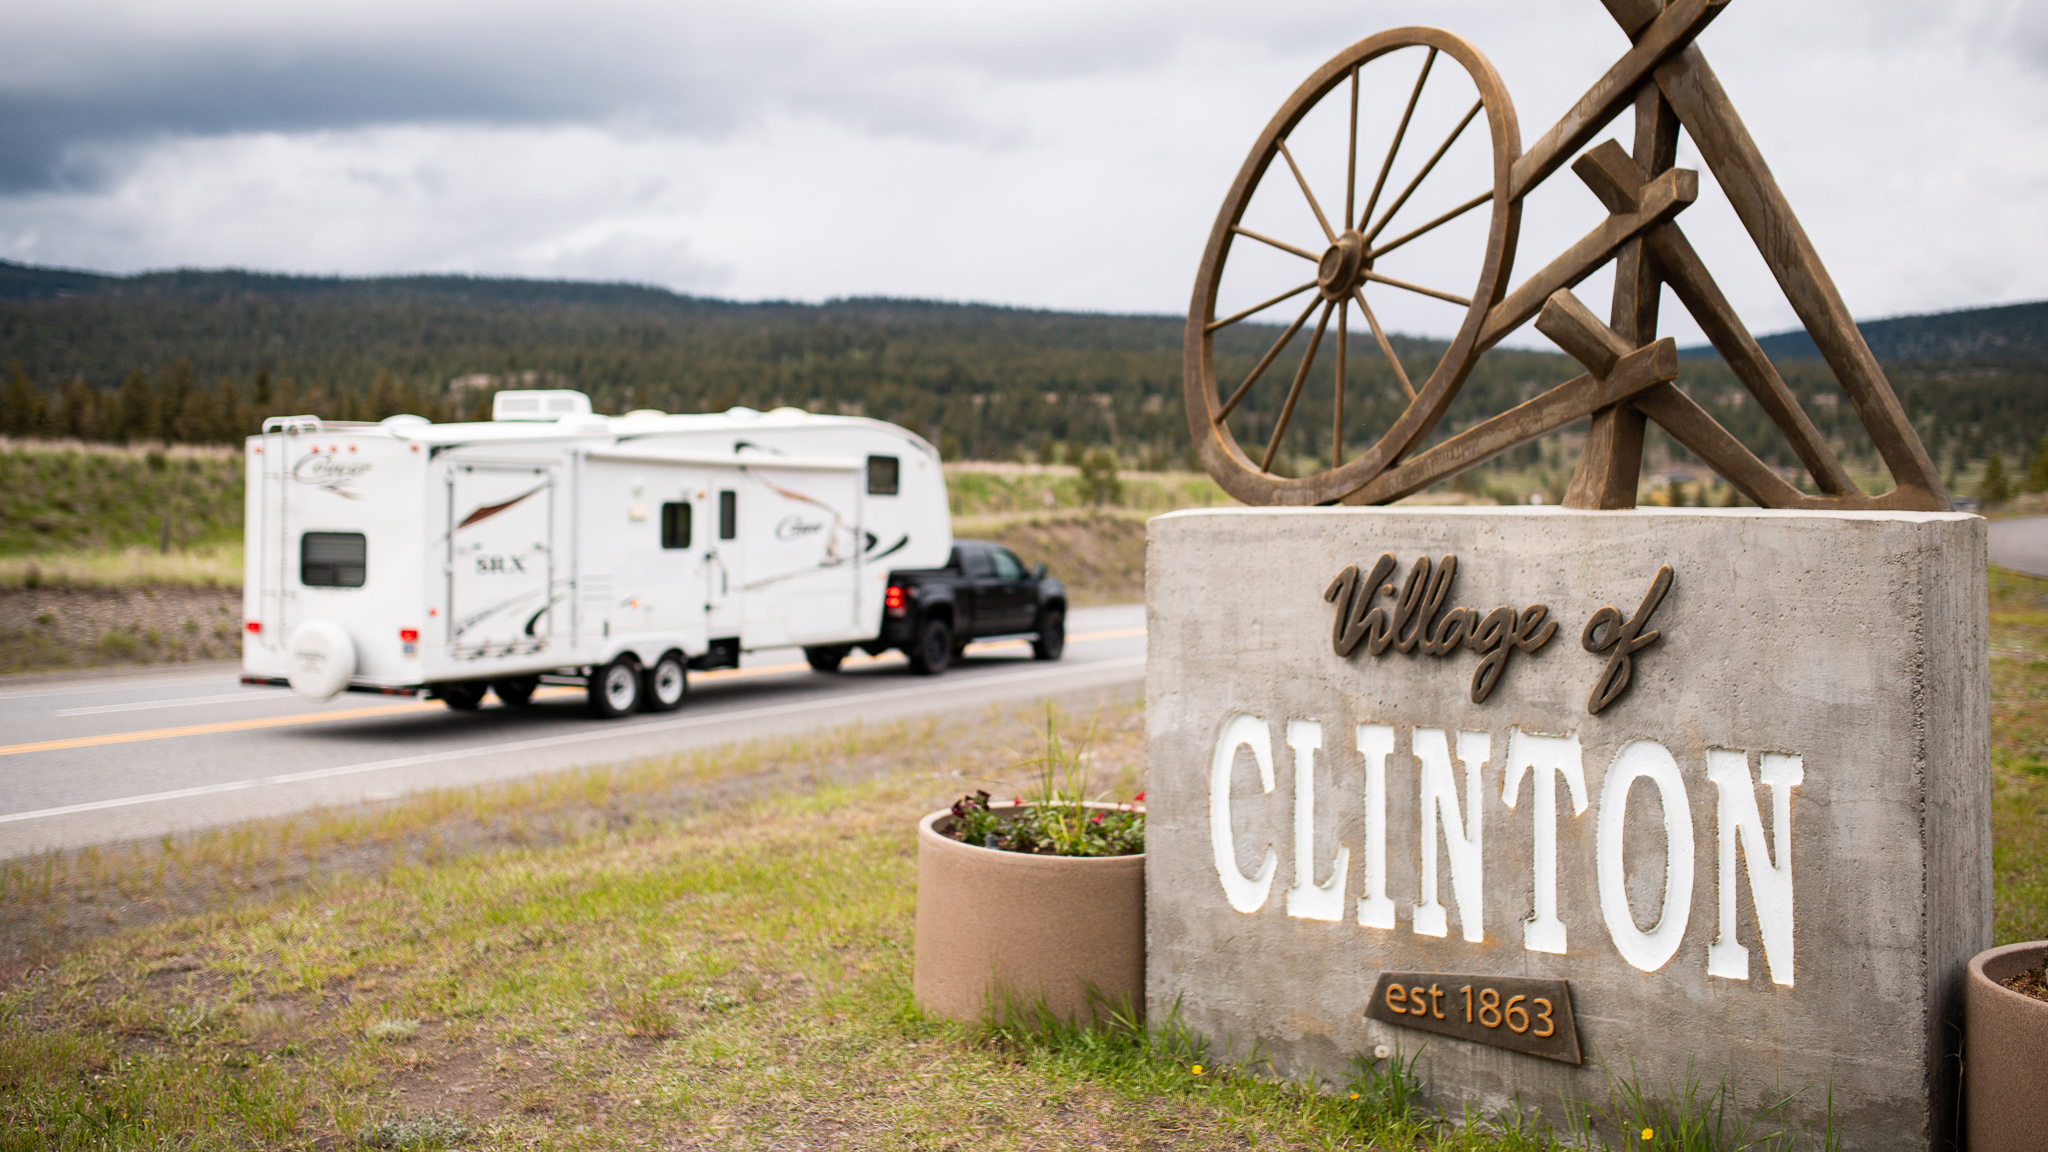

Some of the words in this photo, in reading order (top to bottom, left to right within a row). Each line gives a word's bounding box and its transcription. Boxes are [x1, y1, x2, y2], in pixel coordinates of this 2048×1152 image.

[475, 554, 527, 574] SRX
[1324, 551, 1559, 703] Village
[1582, 564, 1674, 715] of
[1209, 714, 1804, 987] CLINTON
[1385, 983, 1446, 1019] est
[1460, 985, 1555, 1037] 1863
